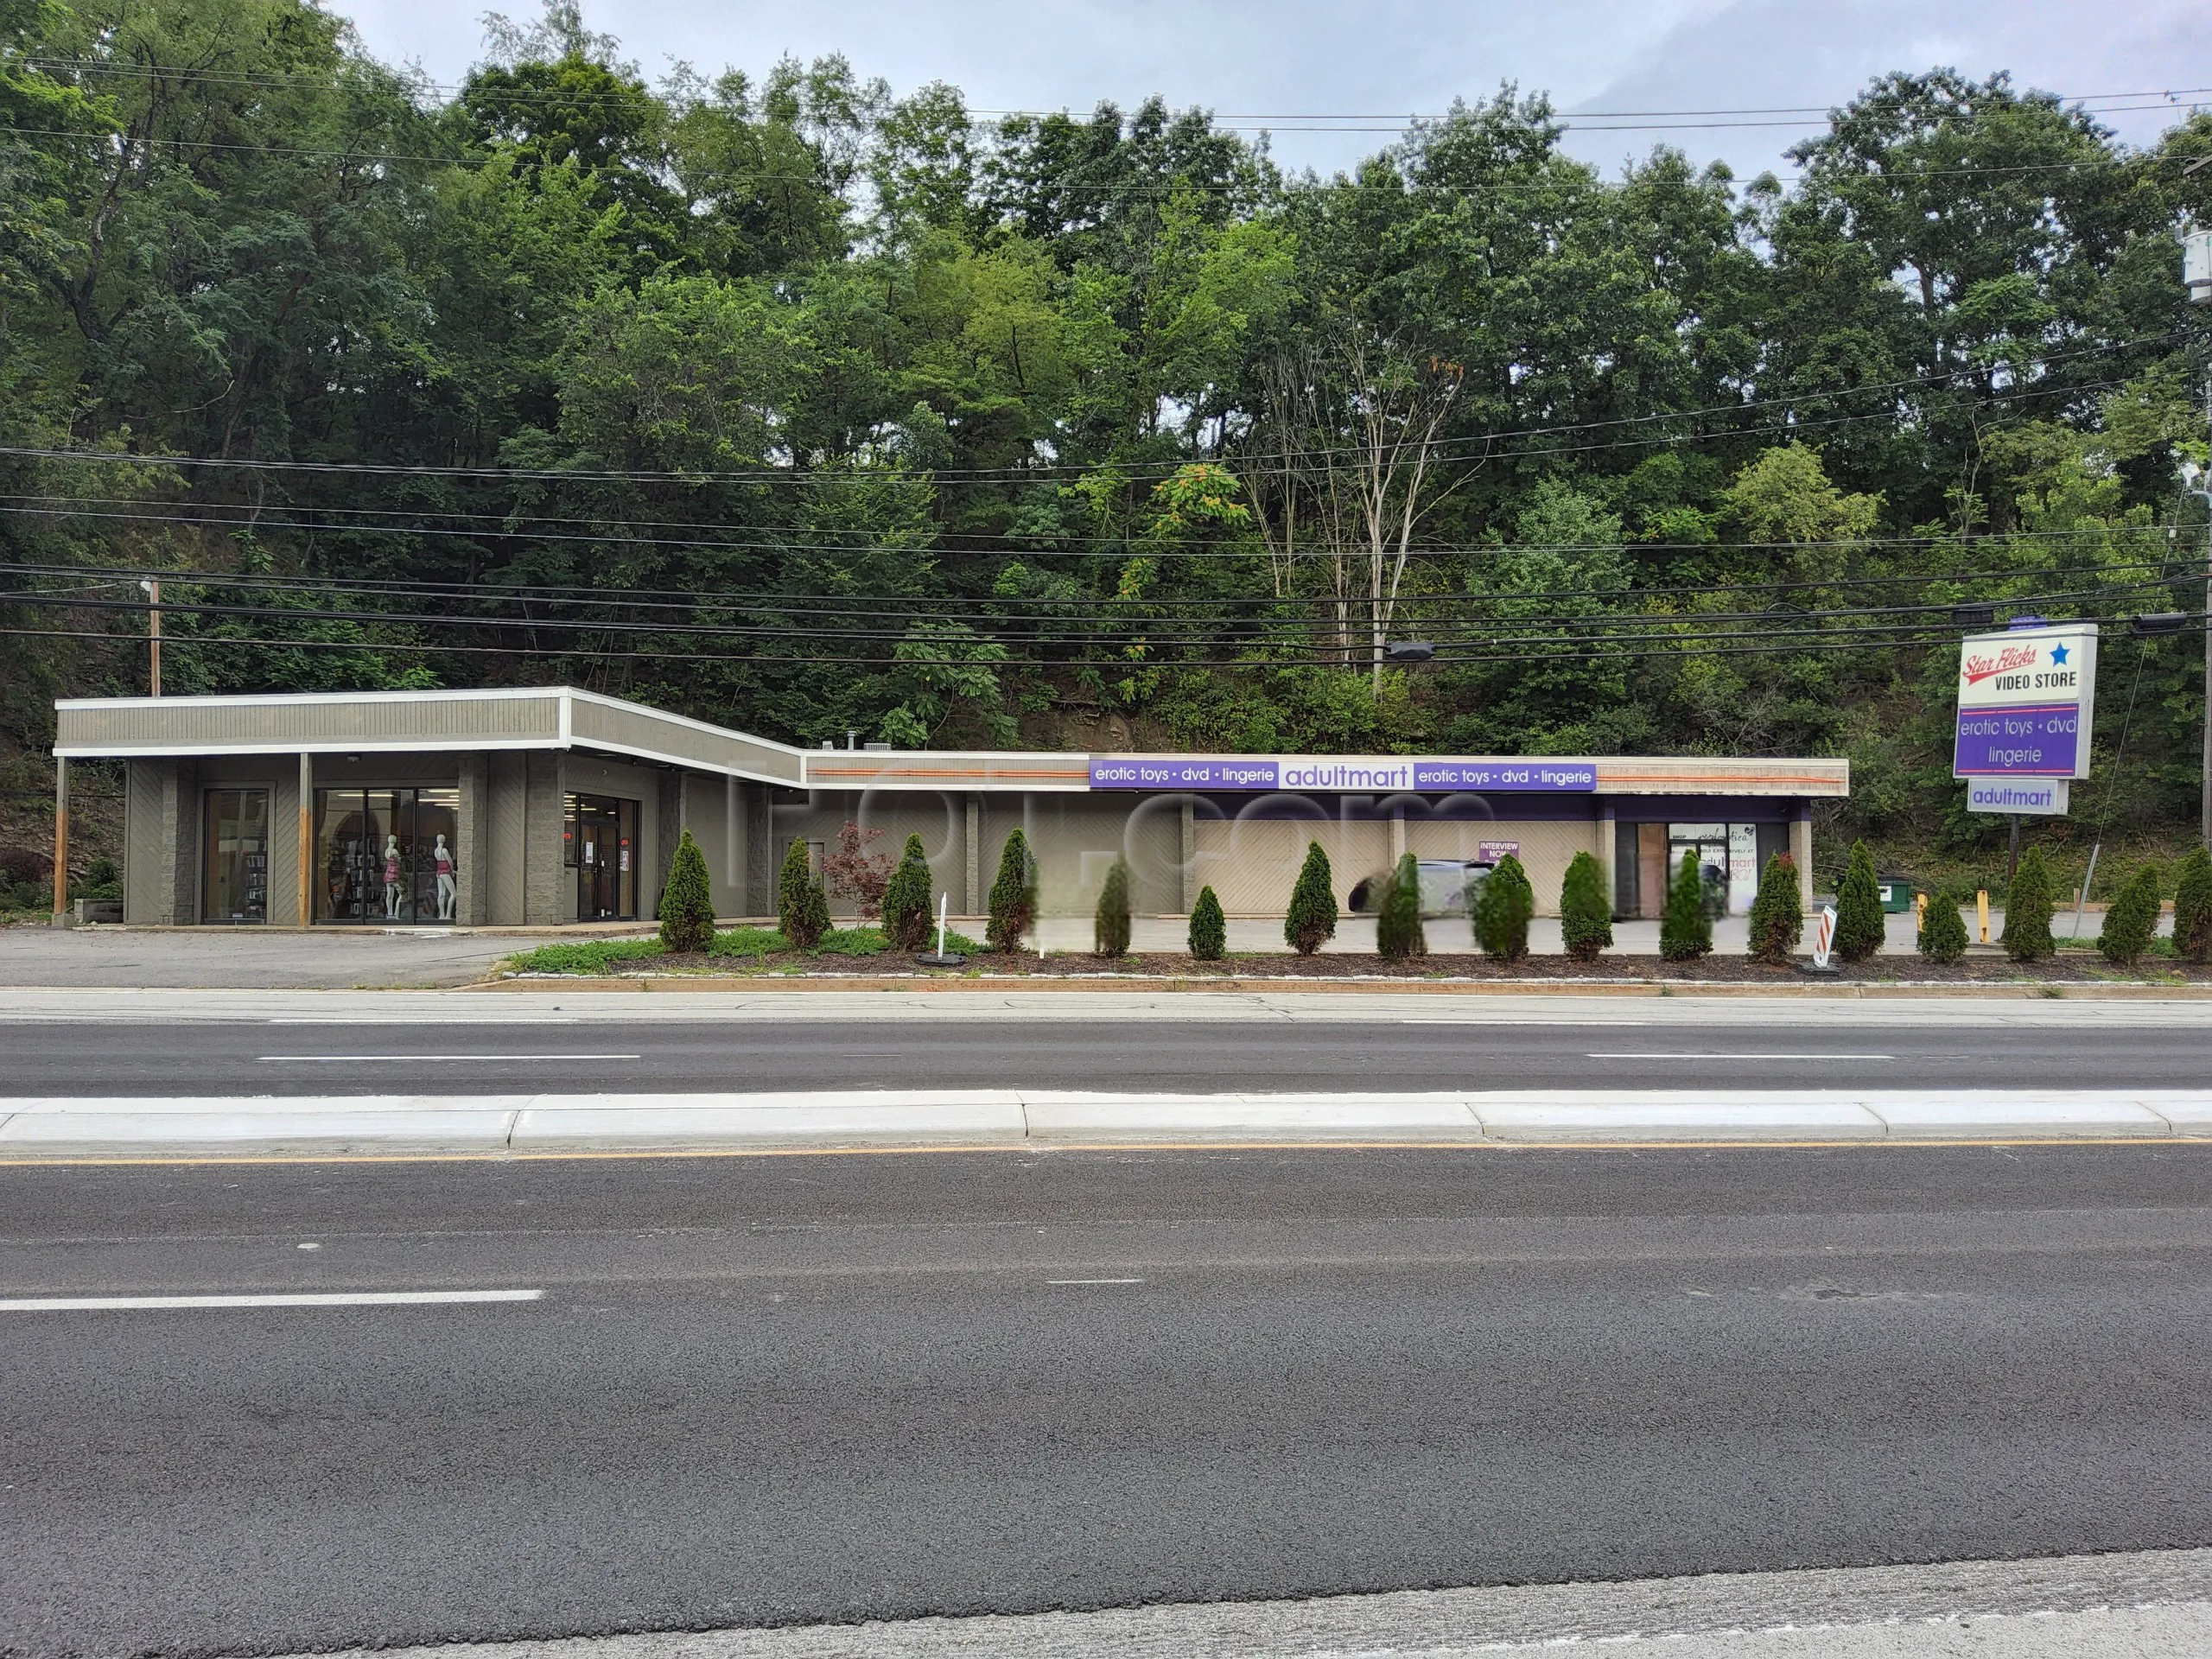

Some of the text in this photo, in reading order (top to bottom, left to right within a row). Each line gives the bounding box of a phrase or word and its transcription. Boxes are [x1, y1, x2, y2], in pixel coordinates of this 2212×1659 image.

[1962, 644, 2037, 677] Star Flicks
[1995, 671, 2077, 690] VIDEO STORE
[1961, 715, 2076, 738] erotic toys dvd
[1988, 747, 2042, 767] lingerie
[1095, 767, 1274, 785] erotic toys dvd lingerie
[1285, 765, 1408, 787] adultmart
[1418, 769, 1592, 786] erotic toys dvd lingerie
[1973, 787, 2052, 807] adultmart
[1480, 842, 1518, 850] INTERVIEW
